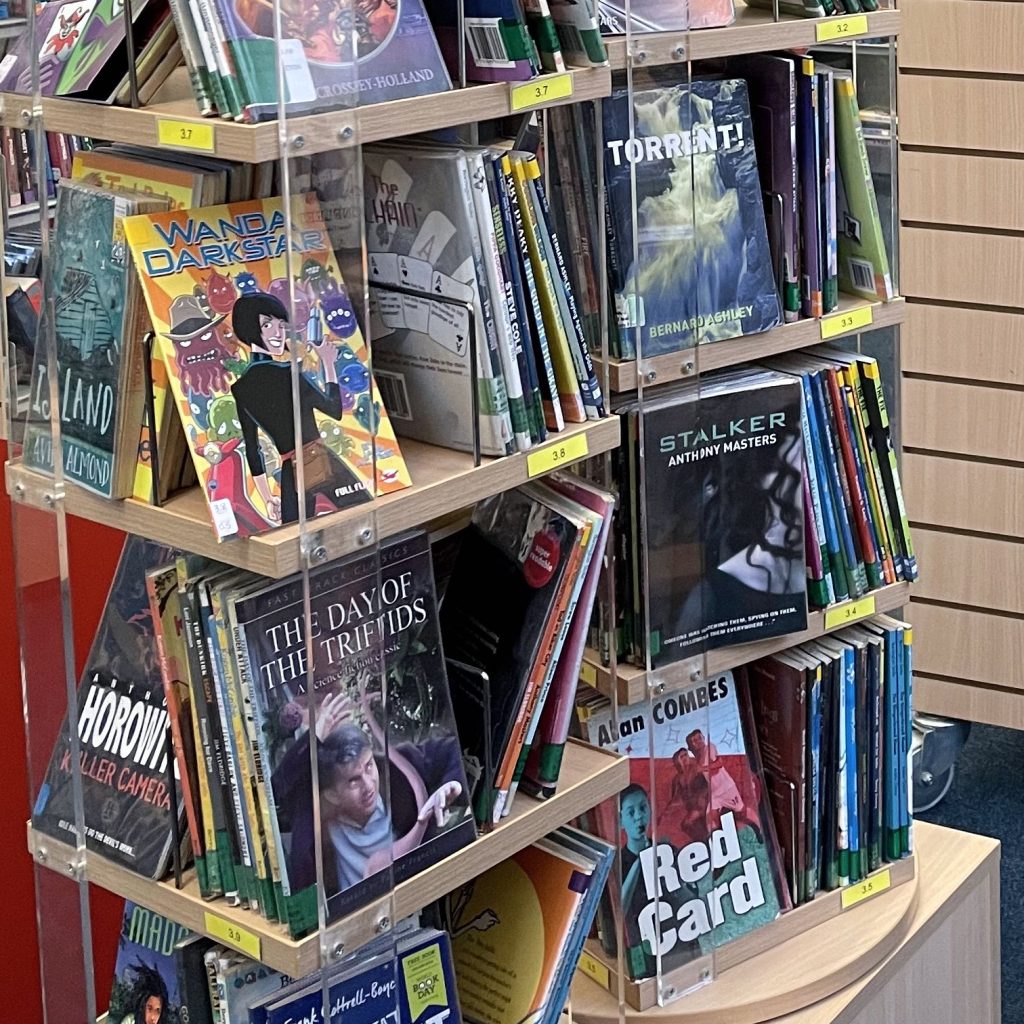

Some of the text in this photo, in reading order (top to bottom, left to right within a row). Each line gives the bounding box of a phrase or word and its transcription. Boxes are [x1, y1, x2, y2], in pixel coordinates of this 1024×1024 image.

[837, 23, 849, 33] 3.2
[535, 85, 548, 98] 3.7
[180, 129, 193, 140] 3.7
[607, 123, 744, 166] TORRENT!
[154, 210, 297, 248] WANDA
[143, 231, 325, 277] DARKSTAR
[548, 233, 565, 266] BERNARD
[503, 281, 523, 354] STEVE COLE
[649, 305, 754, 338] BERNARD ASHLEY
[842, 317, 853, 328] 3.3
[660, 412, 786, 453] STALKER
[668, 434, 777, 467] ANTHONY MASTERS
[66, 445, 110, 488] ALMOND
[552, 447, 565, 461] 3.8
[353, 547, 409, 575] CLASICS
[191, 621, 200, 637] THE
[266, 571, 412, 653] THE DAY OF
[845, 608, 857, 618] 3.4
[231, 626, 248, 684] UNDER ATTACK
[260, 648, 316, 690] THE
[598, 677, 729, 747] Alan COMBES
[78, 685, 180, 780] HOROWI
[251, 739, 265, 783] JIM ELDRIDGE
[118, 768, 171, 811] CAMERA
[639, 811, 742, 901] Red
[861, 882, 873, 893] 3.5
[637, 857, 766, 957] Card
[412, 975, 440, 993] BOOK
[417, 985, 437, 1000] DAY
